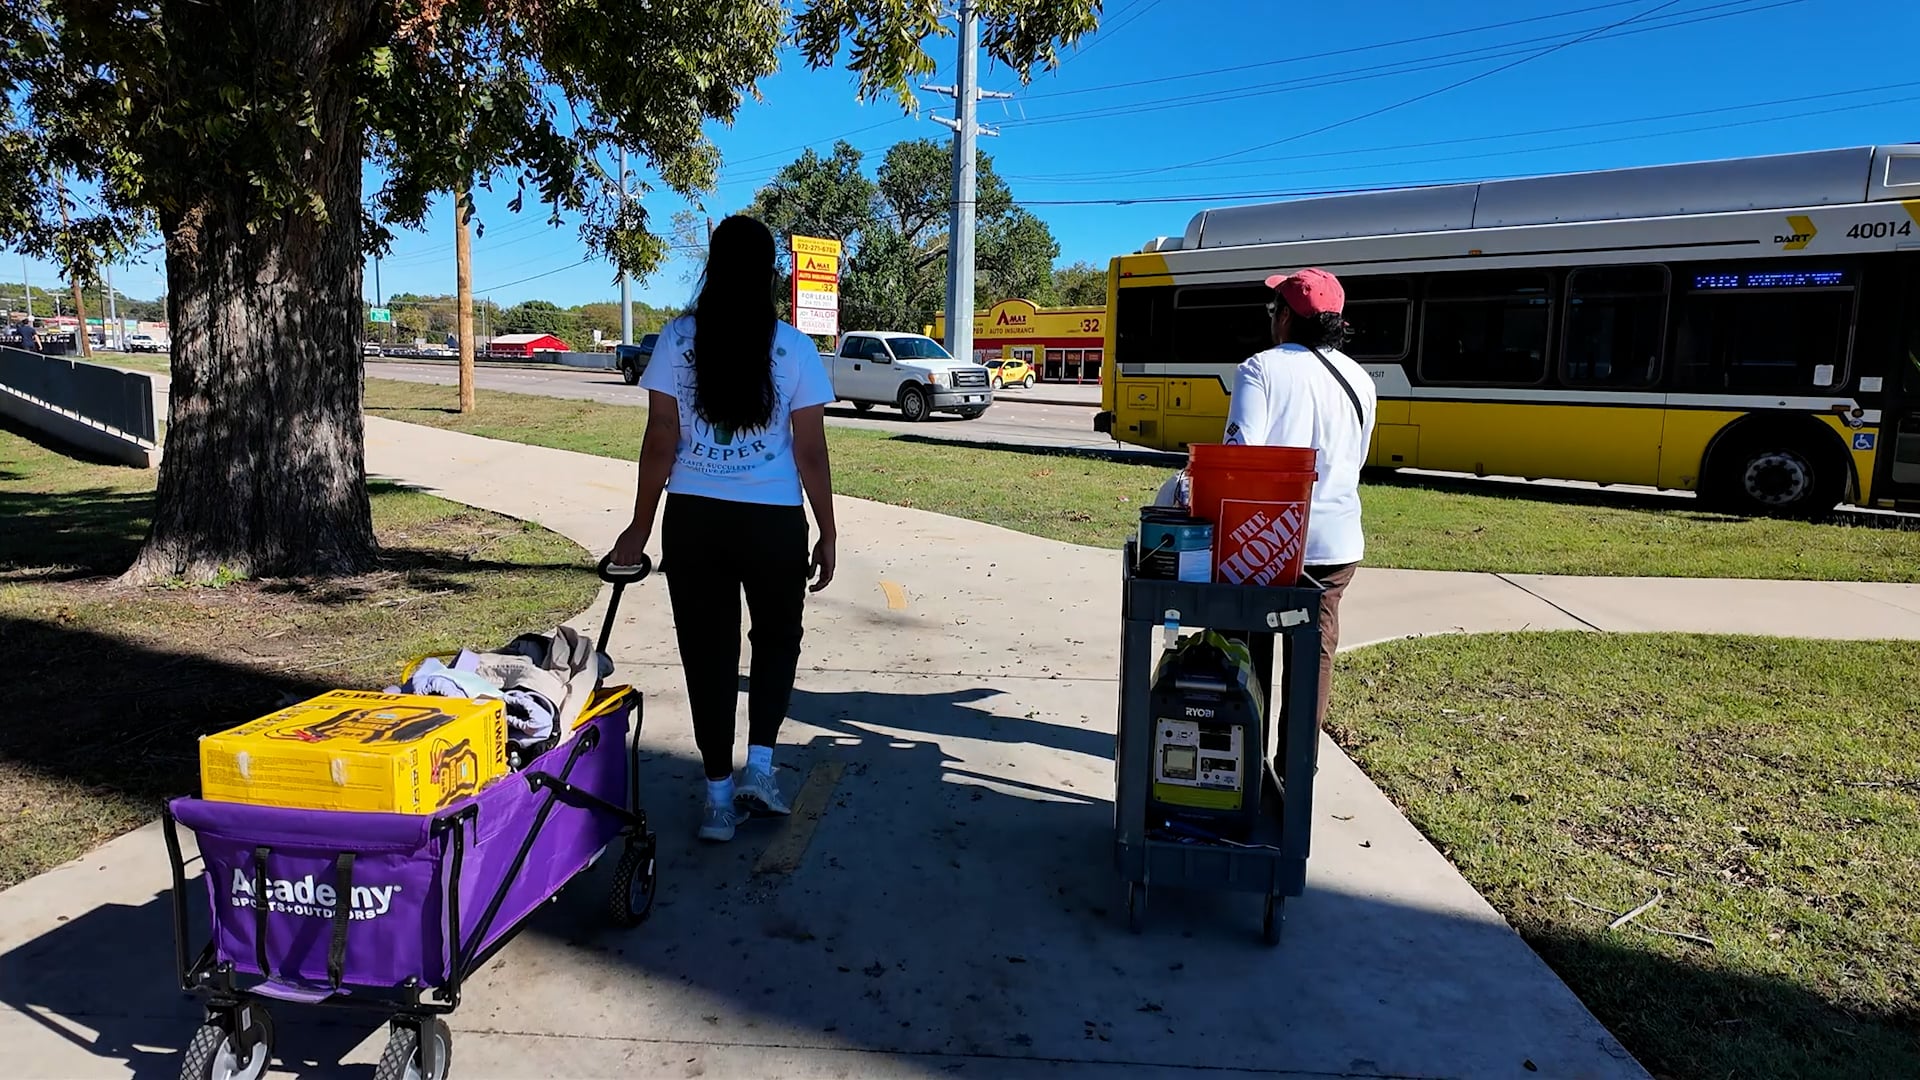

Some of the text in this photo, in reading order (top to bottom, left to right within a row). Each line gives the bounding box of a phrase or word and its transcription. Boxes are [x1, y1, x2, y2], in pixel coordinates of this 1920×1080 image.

[1846, 220, 1911, 239] 40014
[1774, 234, 1810, 243] DART
[810, 310, 836, 319] TAILOR
[989, 327, 1004, 335] AUTO
[1229, 511, 1270, 545] THE
[1220, 502, 1304, 585] HOME
[1253, 534, 1301, 587] DEPOT
[1185, 706, 1215, 718] RYOBI
